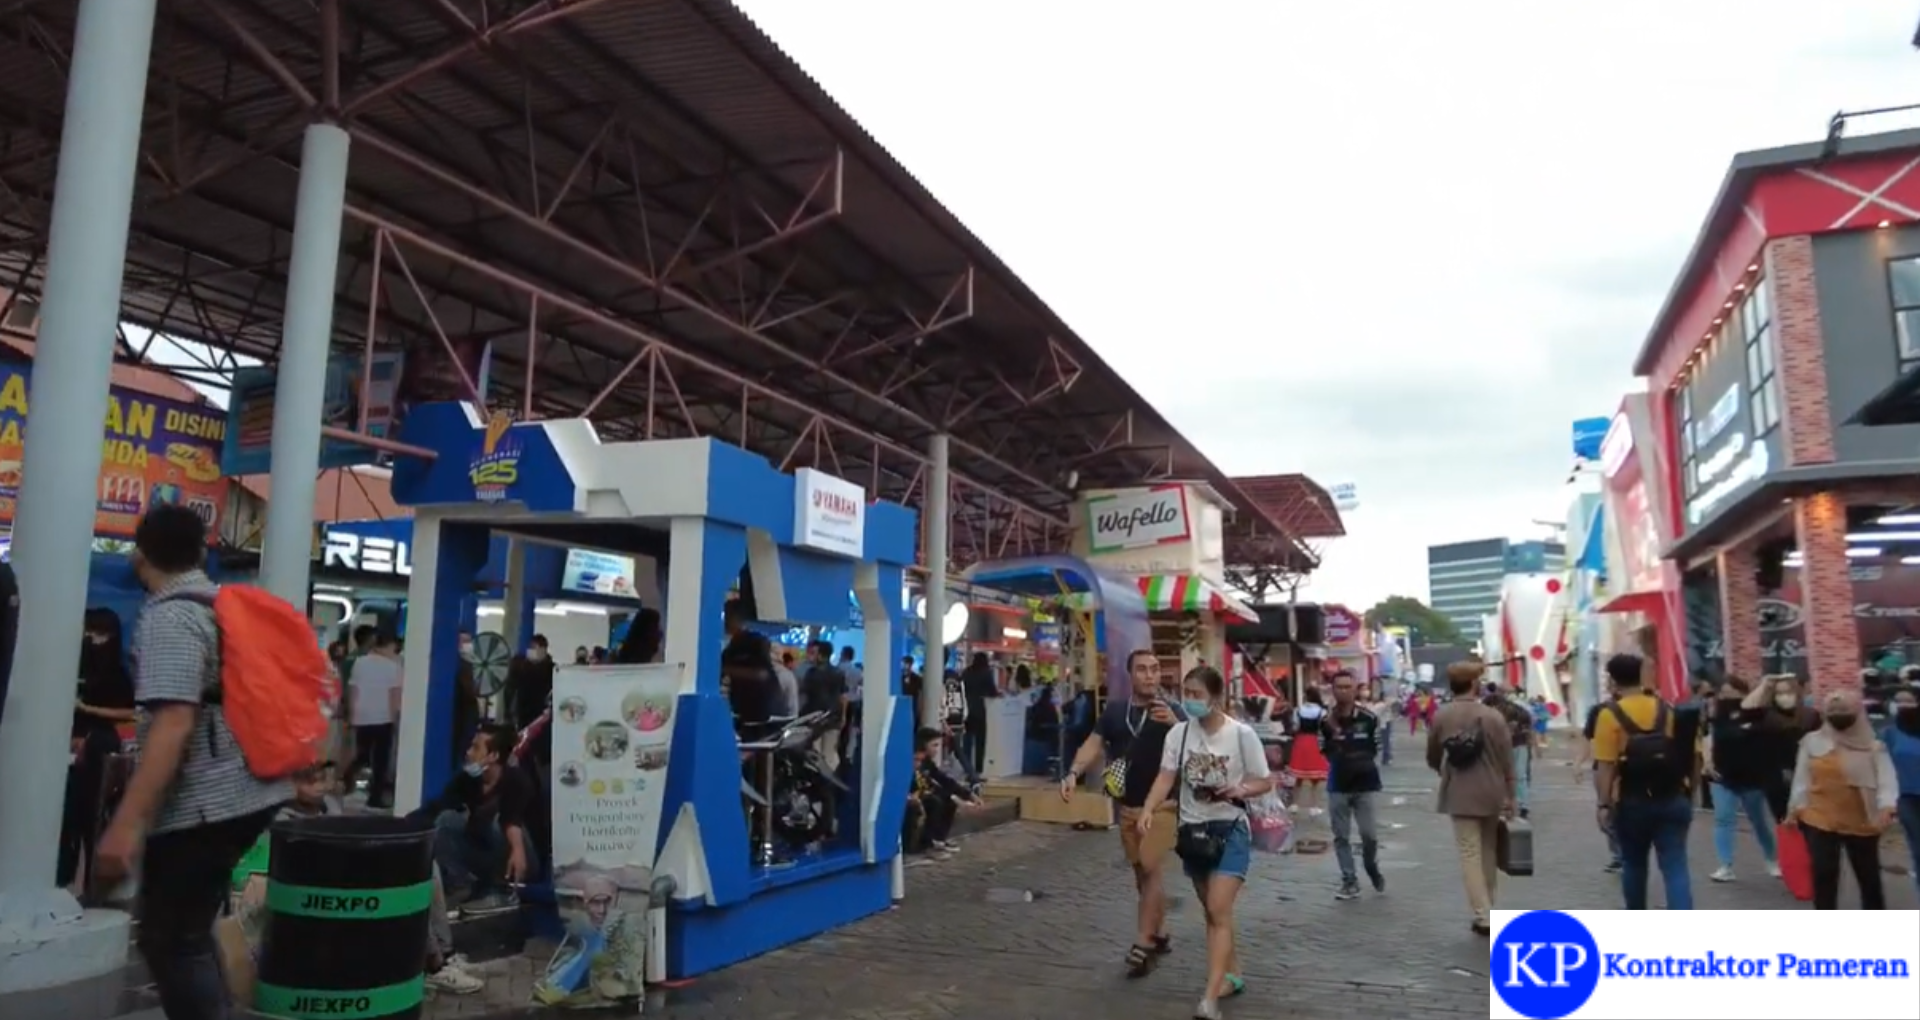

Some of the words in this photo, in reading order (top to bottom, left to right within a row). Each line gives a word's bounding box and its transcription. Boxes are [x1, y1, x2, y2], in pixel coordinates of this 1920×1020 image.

[468, 459, 518, 486] 125
[823, 491, 857, 518] YAMAHA
[1097, 500, 1178, 538] Wafello
[301, 894, 380, 912] JIEXPO
[289, 996, 371, 1013] JIEXPO
